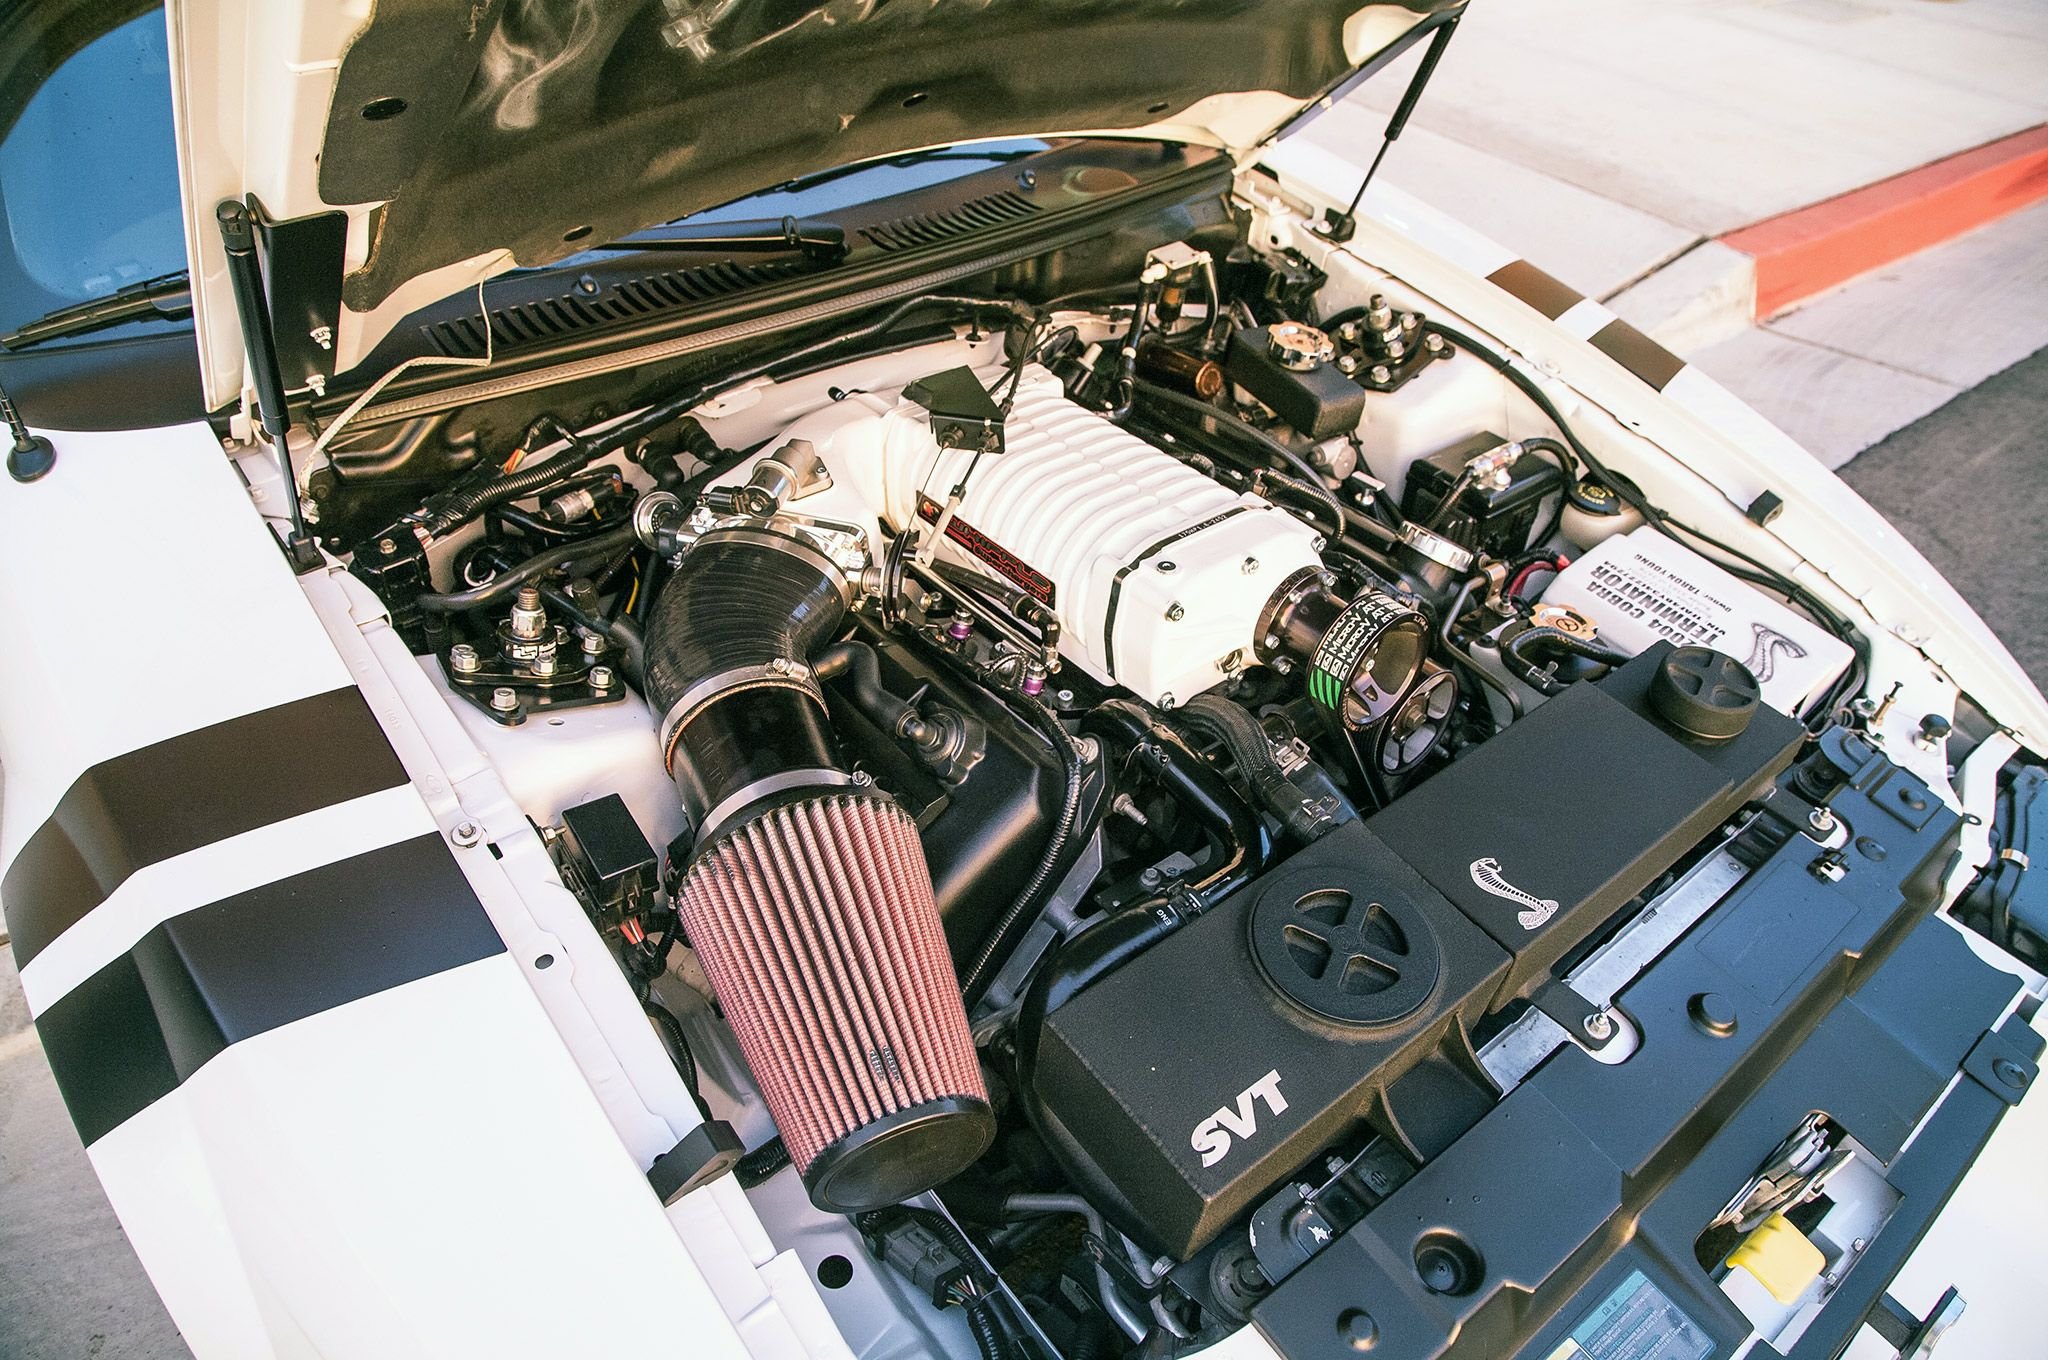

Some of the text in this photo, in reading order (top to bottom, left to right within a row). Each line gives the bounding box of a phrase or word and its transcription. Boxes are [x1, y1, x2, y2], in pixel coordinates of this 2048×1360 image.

[1634, 553, 1667, 575] YOUNG
[1586, 581, 1645, 619] COBRA
[1590, 565, 1719, 646] TERMINATOR
[1156, 909, 1172, 926] ENG
[1191, 1069, 1289, 1168] SVT
